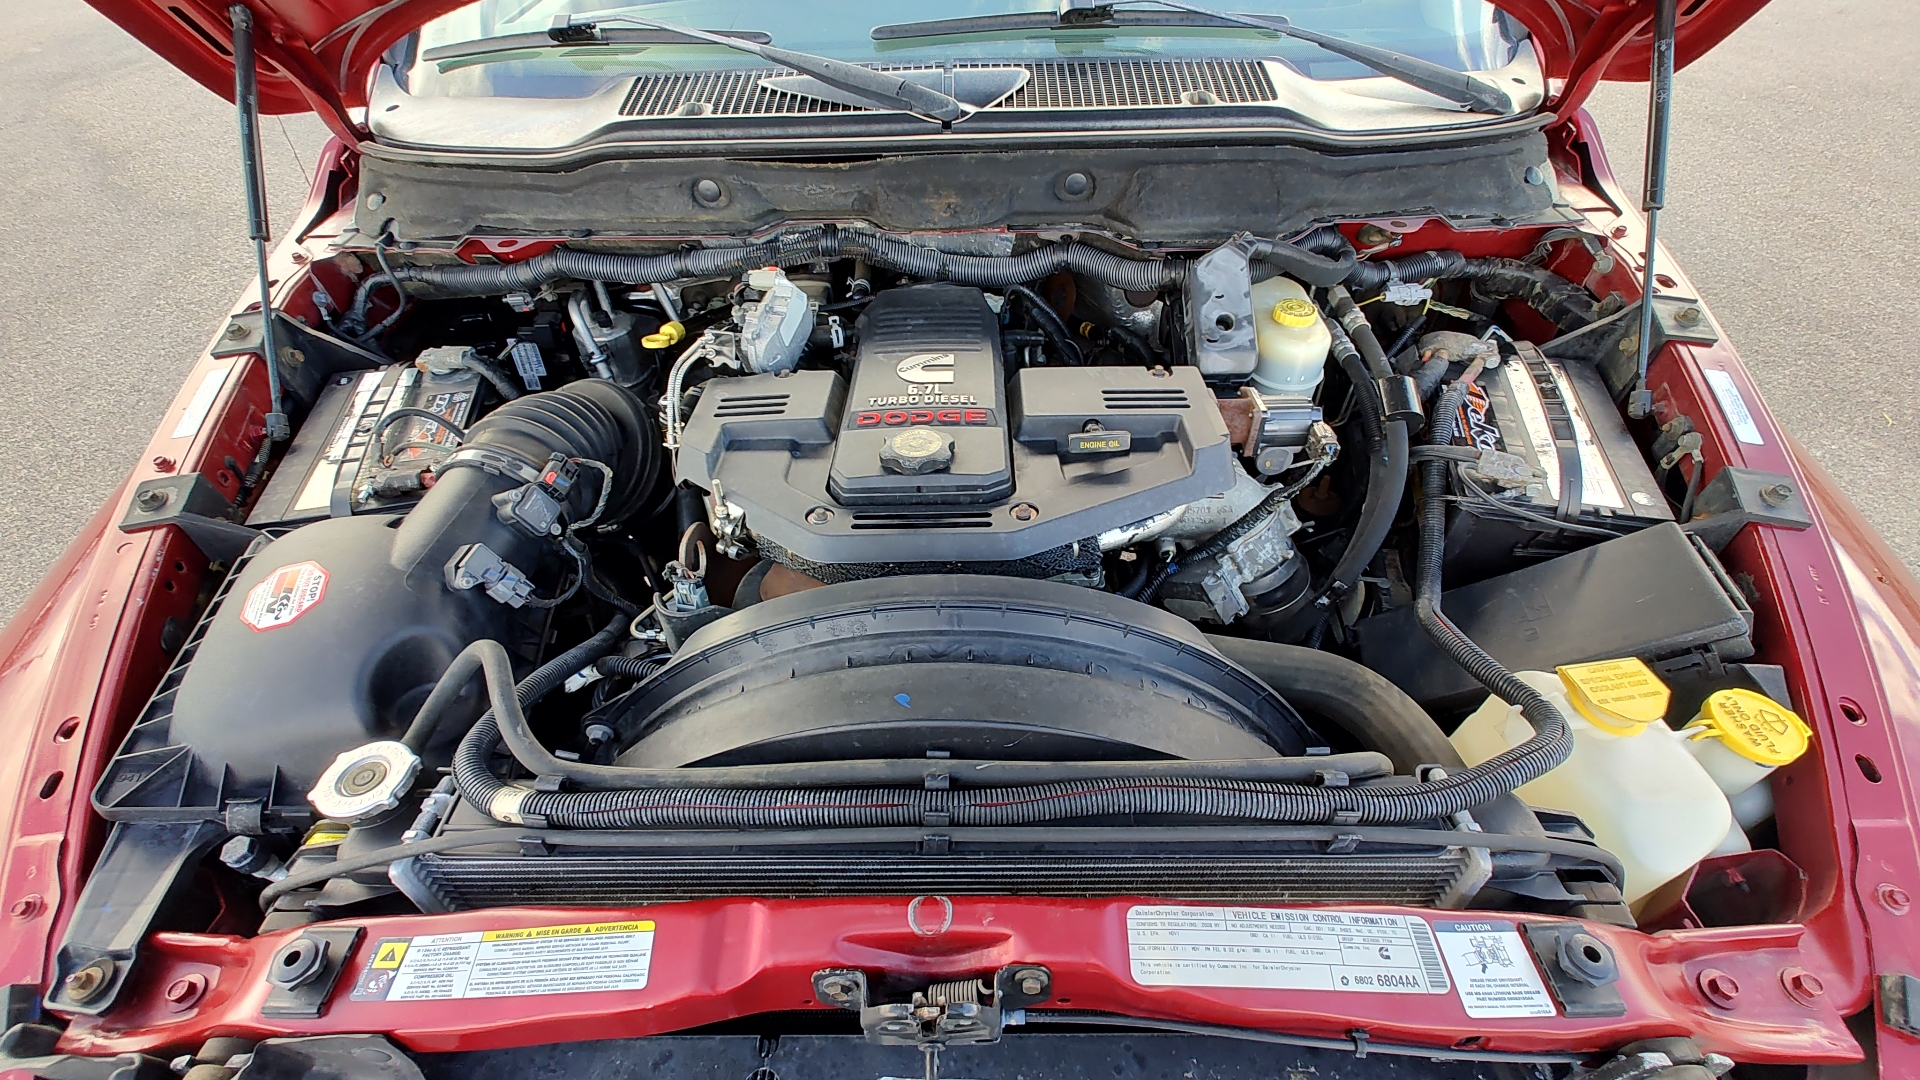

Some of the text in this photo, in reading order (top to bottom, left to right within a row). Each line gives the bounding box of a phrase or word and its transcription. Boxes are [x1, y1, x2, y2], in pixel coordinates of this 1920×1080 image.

[898, 353, 950, 373] Cummins
[907, 383, 943, 395] 6.7L
[868, 395, 977, 406] TURBO DIESEL
[857, 409, 988, 425] DODGE
[1080, 440, 1120, 449] ENGINE OIL
[306, 575, 322, 602] STOP!
[1718, 702, 1762, 747] WASHER
[1723, 695, 1782, 754] FLUID ONLY
[1232, 911, 1399, 926] VEHICLE EMISSION CONTROL INFORMATION
[595, 924, 639, 932] ADVERTENCIA
[1454, 923, 1492, 931] CAUTION
[431, 936, 463, 944] ATTENTION
[1354, 974, 1420, 988] 6802 6804AA
